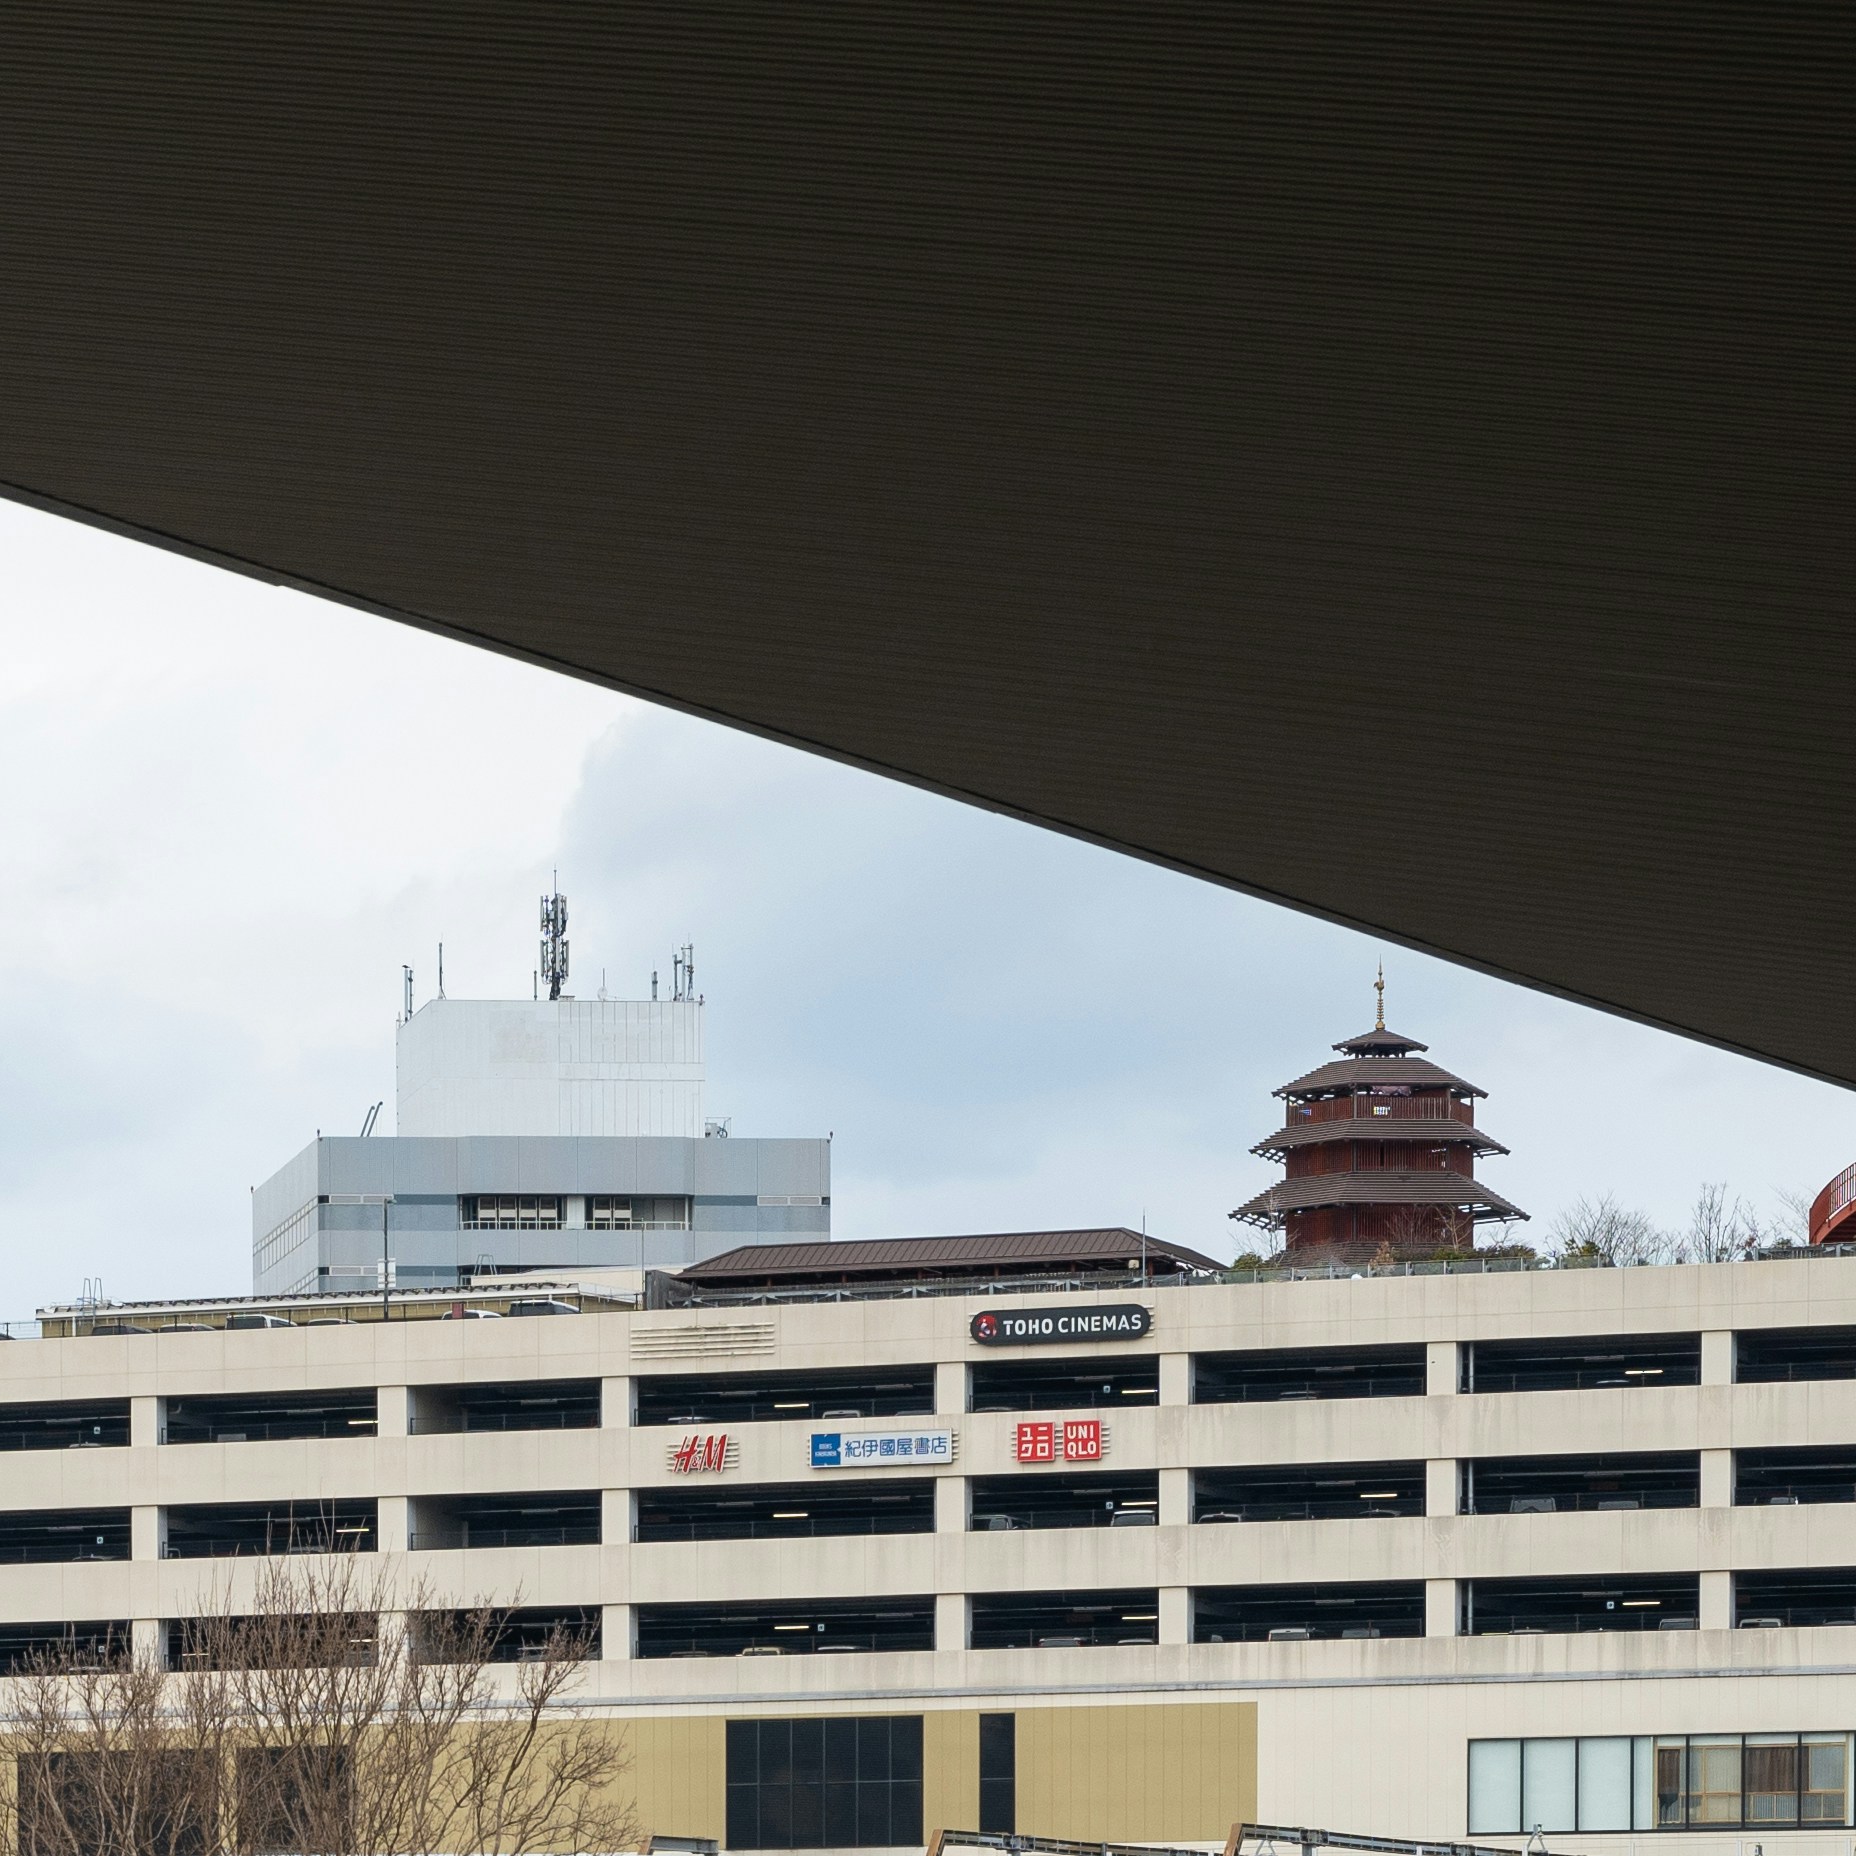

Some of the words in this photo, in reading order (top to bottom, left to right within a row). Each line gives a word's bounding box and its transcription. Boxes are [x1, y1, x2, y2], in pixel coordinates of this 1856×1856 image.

[1003, 1318, 1053, 1336] TOHO
[1057, 1314, 1142, 1333] CINEMAS
[673, 1434, 727, 1473] H&M
[844, 1436, 948, 1457] 紀伊國屋書店
